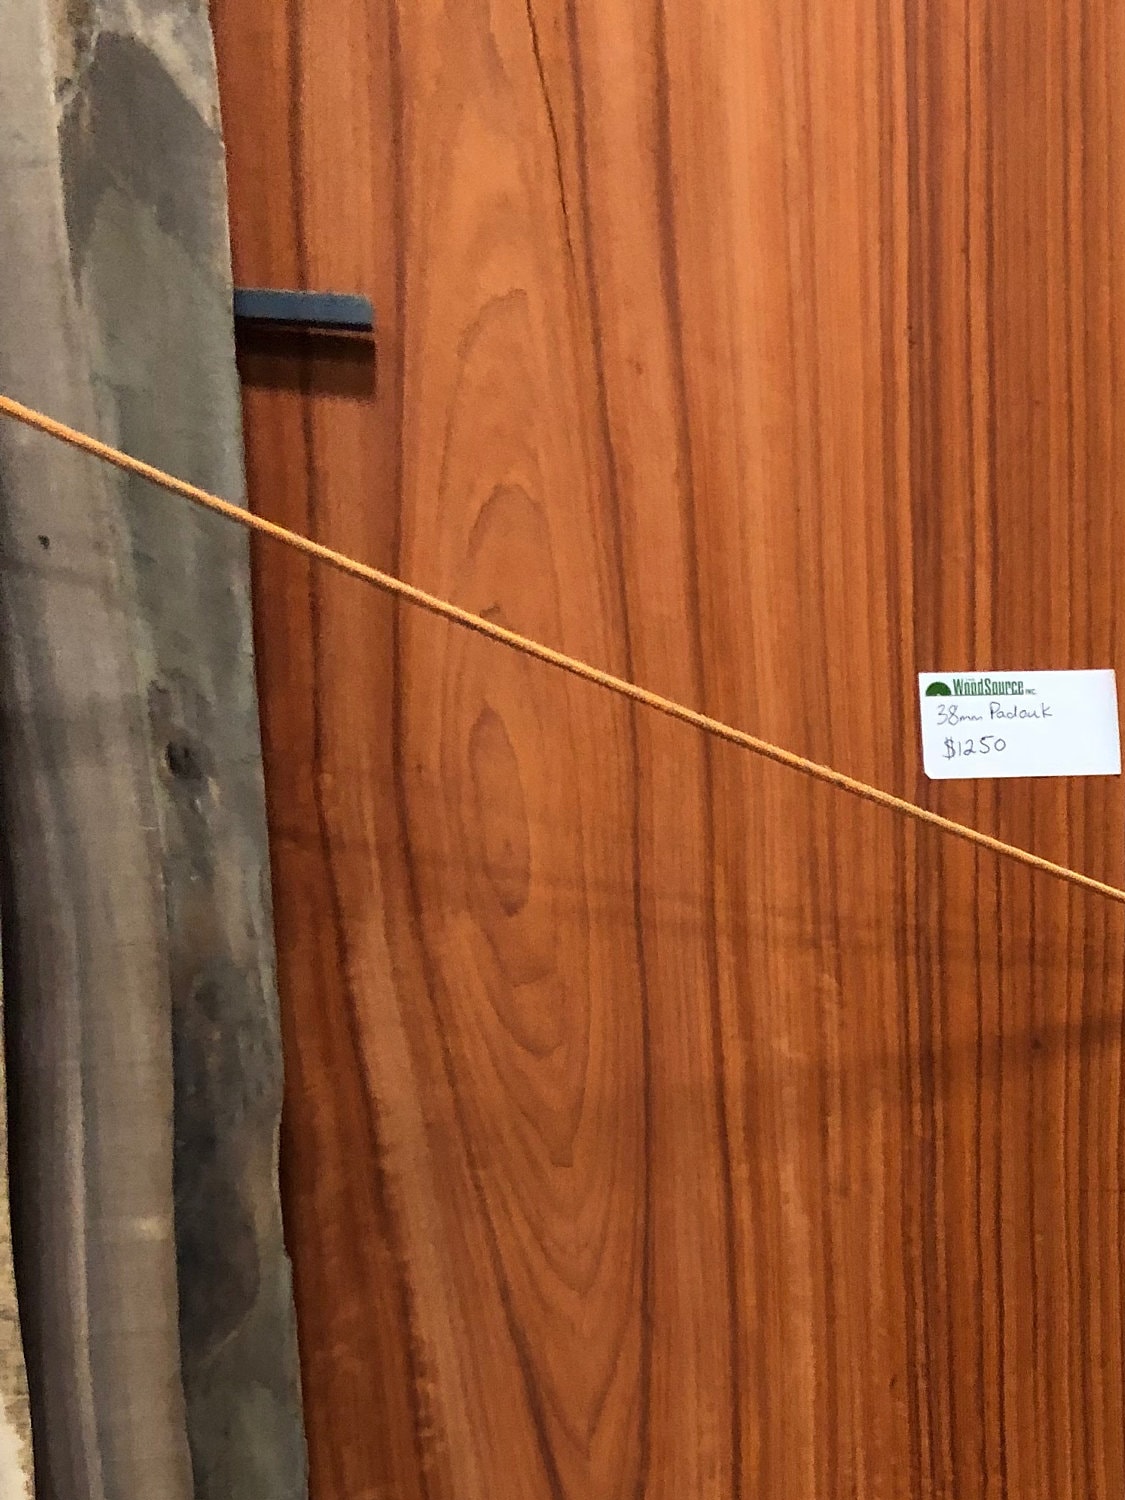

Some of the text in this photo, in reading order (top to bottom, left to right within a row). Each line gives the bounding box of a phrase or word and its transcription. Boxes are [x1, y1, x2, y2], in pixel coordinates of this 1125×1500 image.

[953, 678, 1024, 696] WoodSource
[936, 701, 1053, 726] 38mm Padouk
[942, 735, 1006, 760] $1250
